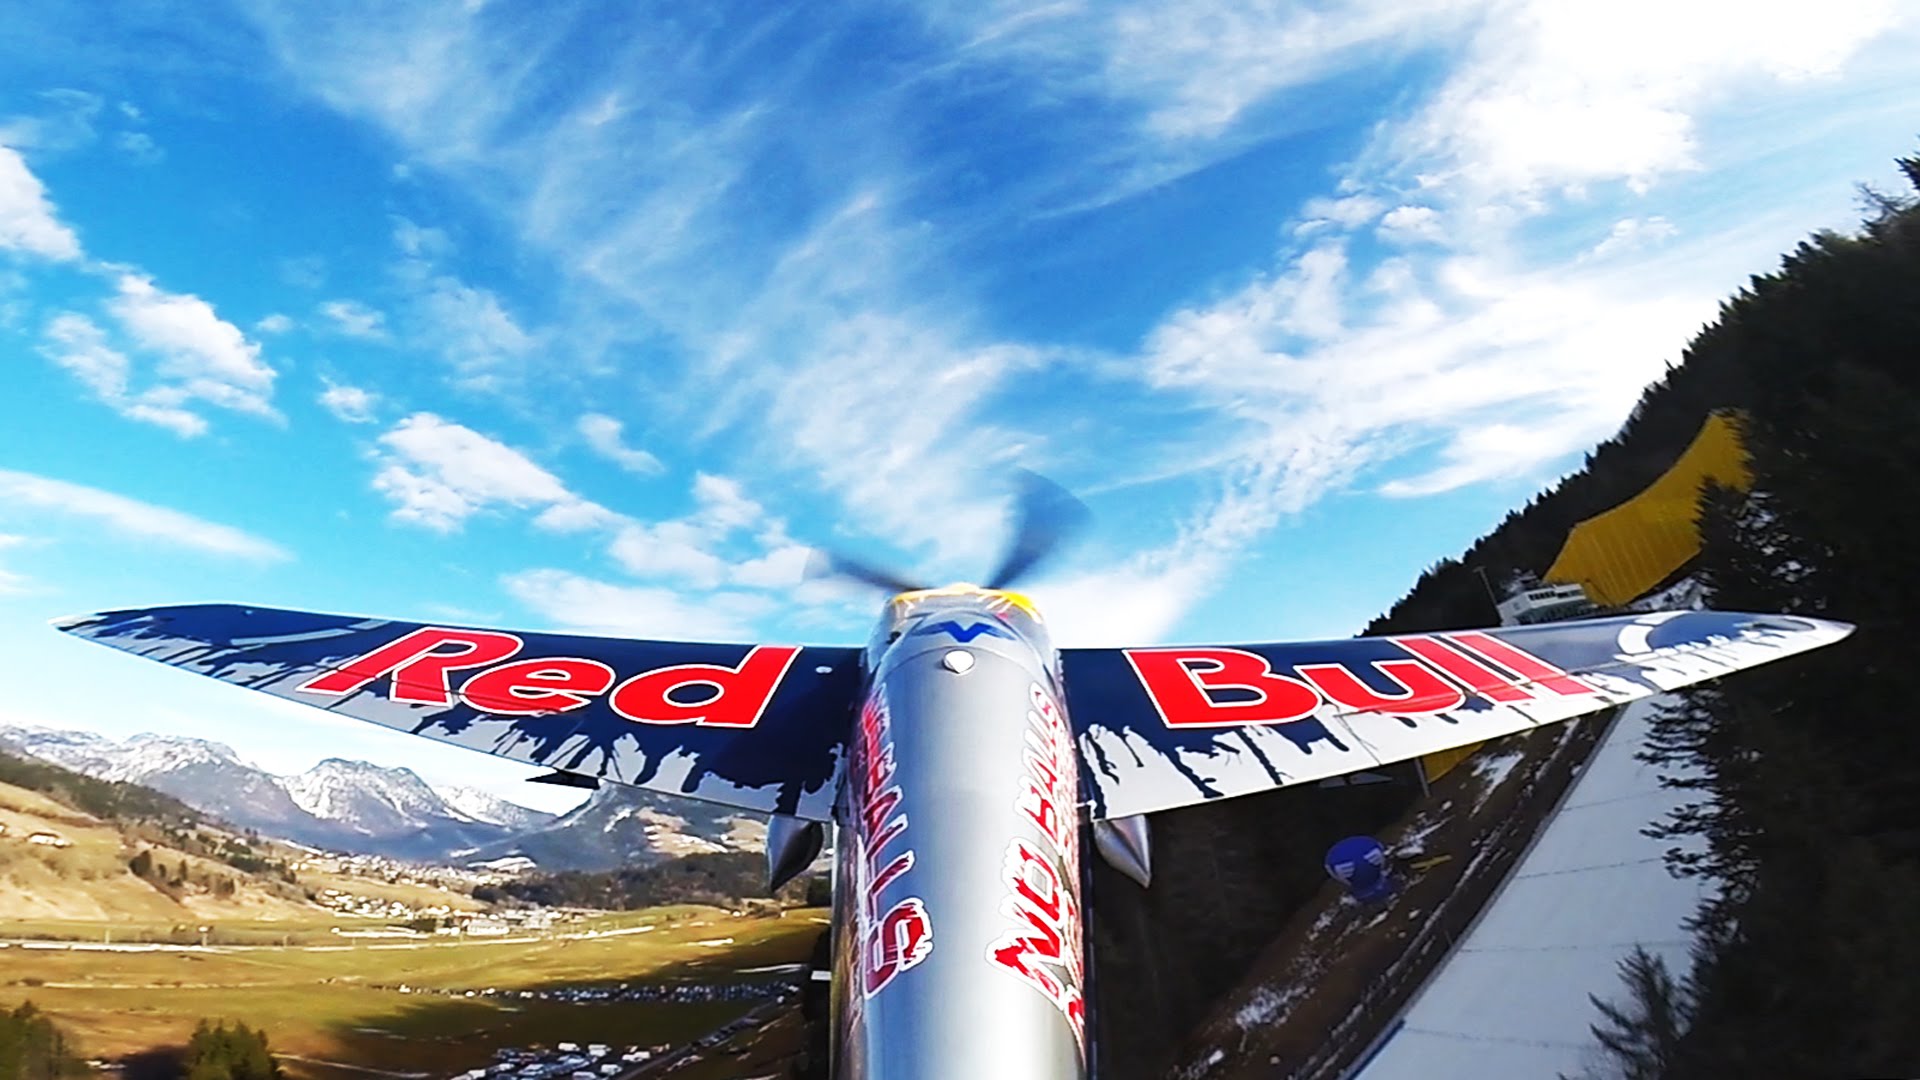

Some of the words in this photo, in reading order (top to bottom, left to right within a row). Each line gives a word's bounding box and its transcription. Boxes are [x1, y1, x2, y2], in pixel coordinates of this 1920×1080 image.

[296, 626, 803, 728] Red
[1122, 631, 1599, 729] Bull
[1014, 681, 1064, 857] BALLS
[862, 742, 933, 1000] BALLS
[985, 837, 1065, 1011] NO
